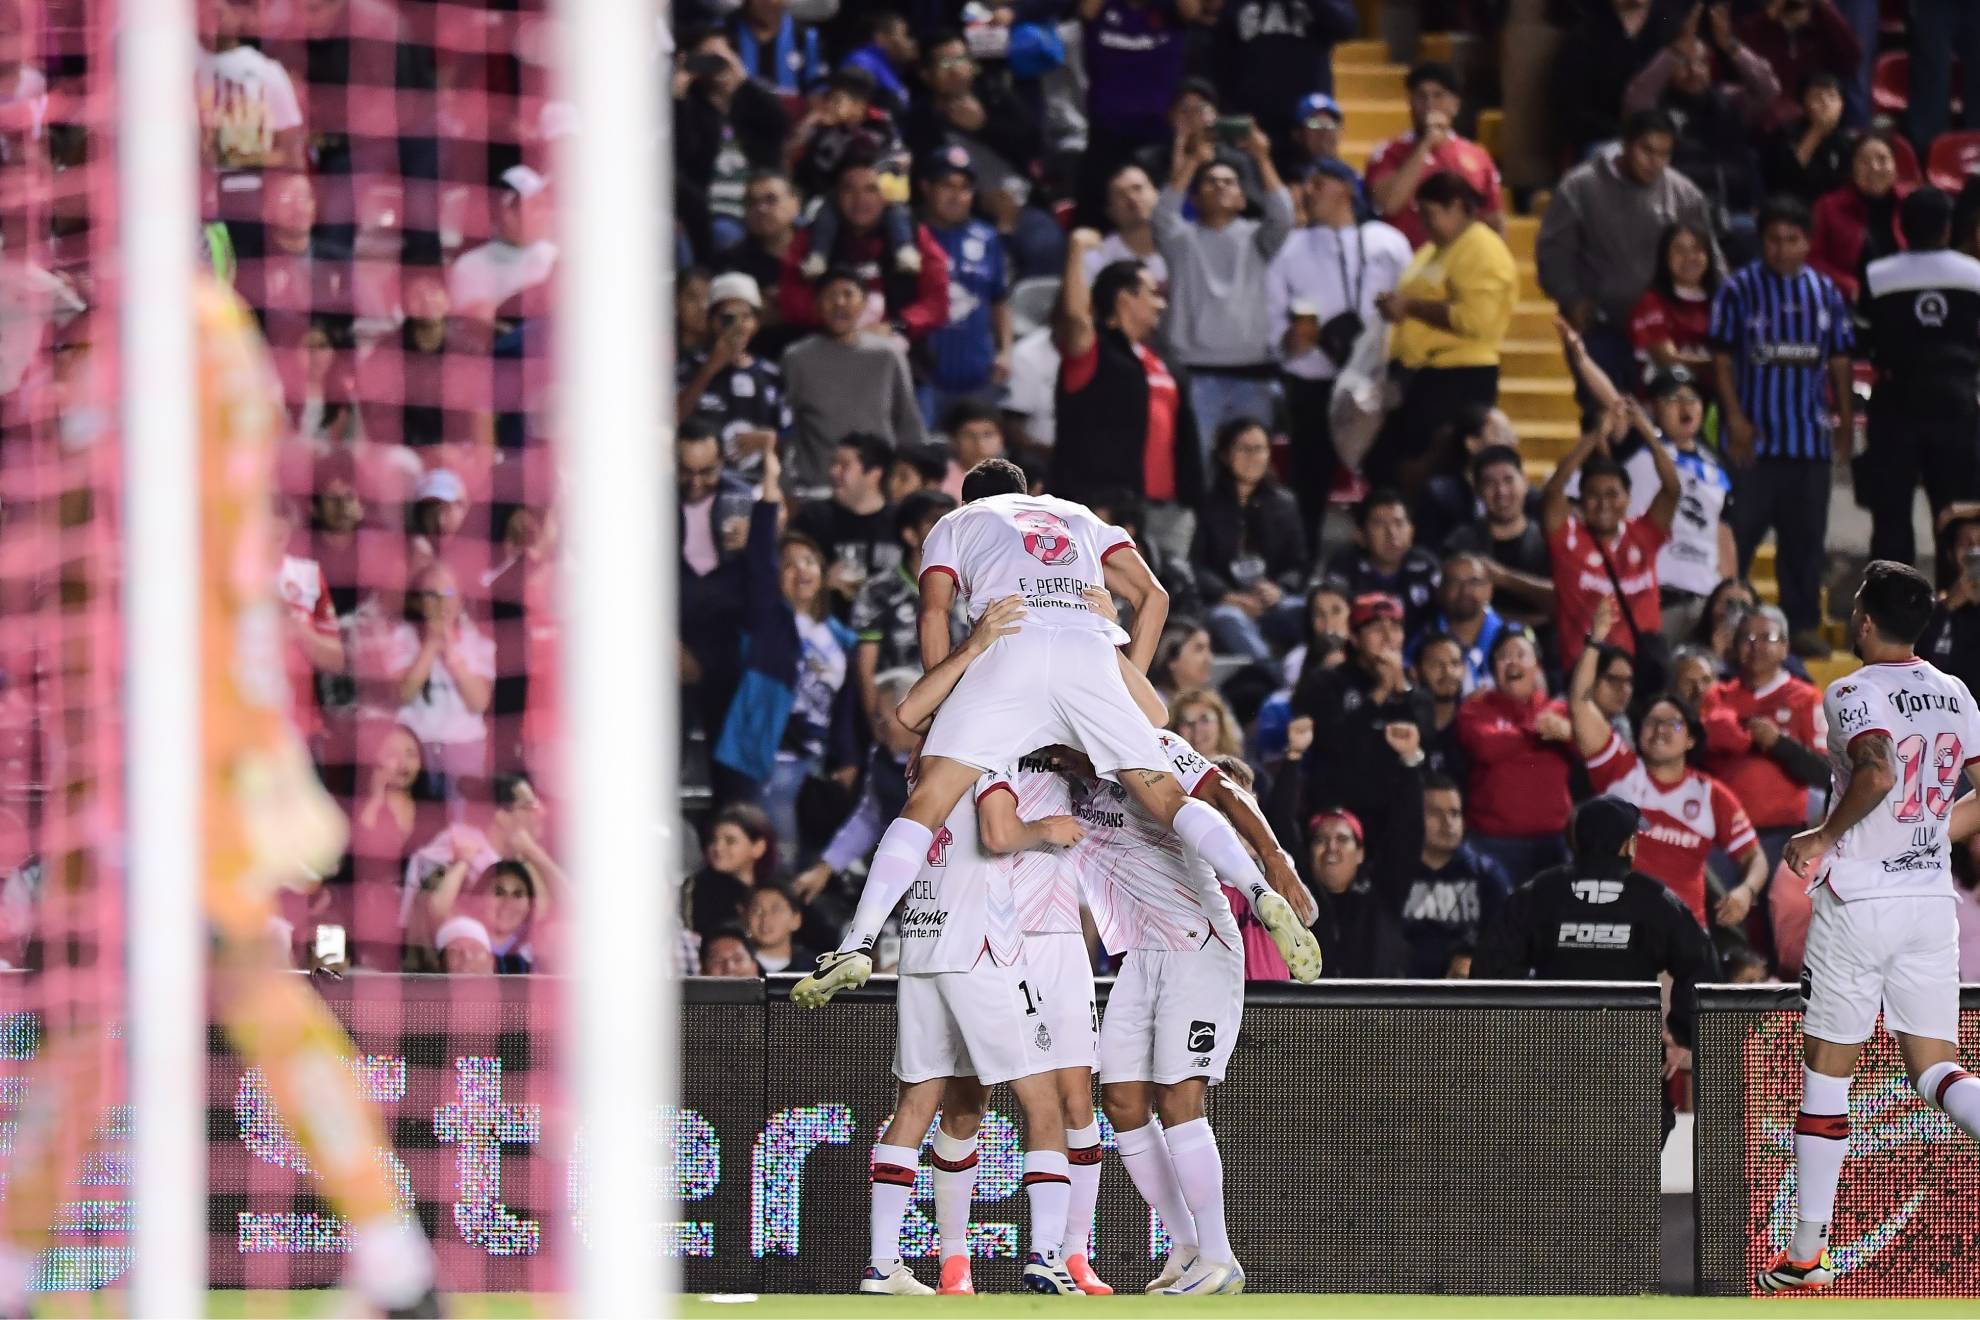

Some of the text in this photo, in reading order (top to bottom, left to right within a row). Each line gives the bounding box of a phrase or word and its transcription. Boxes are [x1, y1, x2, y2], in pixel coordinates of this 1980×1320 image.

[1014, 510, 1078, 566] 6
[1019, 577, 1033, 592] F.
[1023, 598, 1087, 611] aliente.m
[1893, 732, 1965, 824] 19
